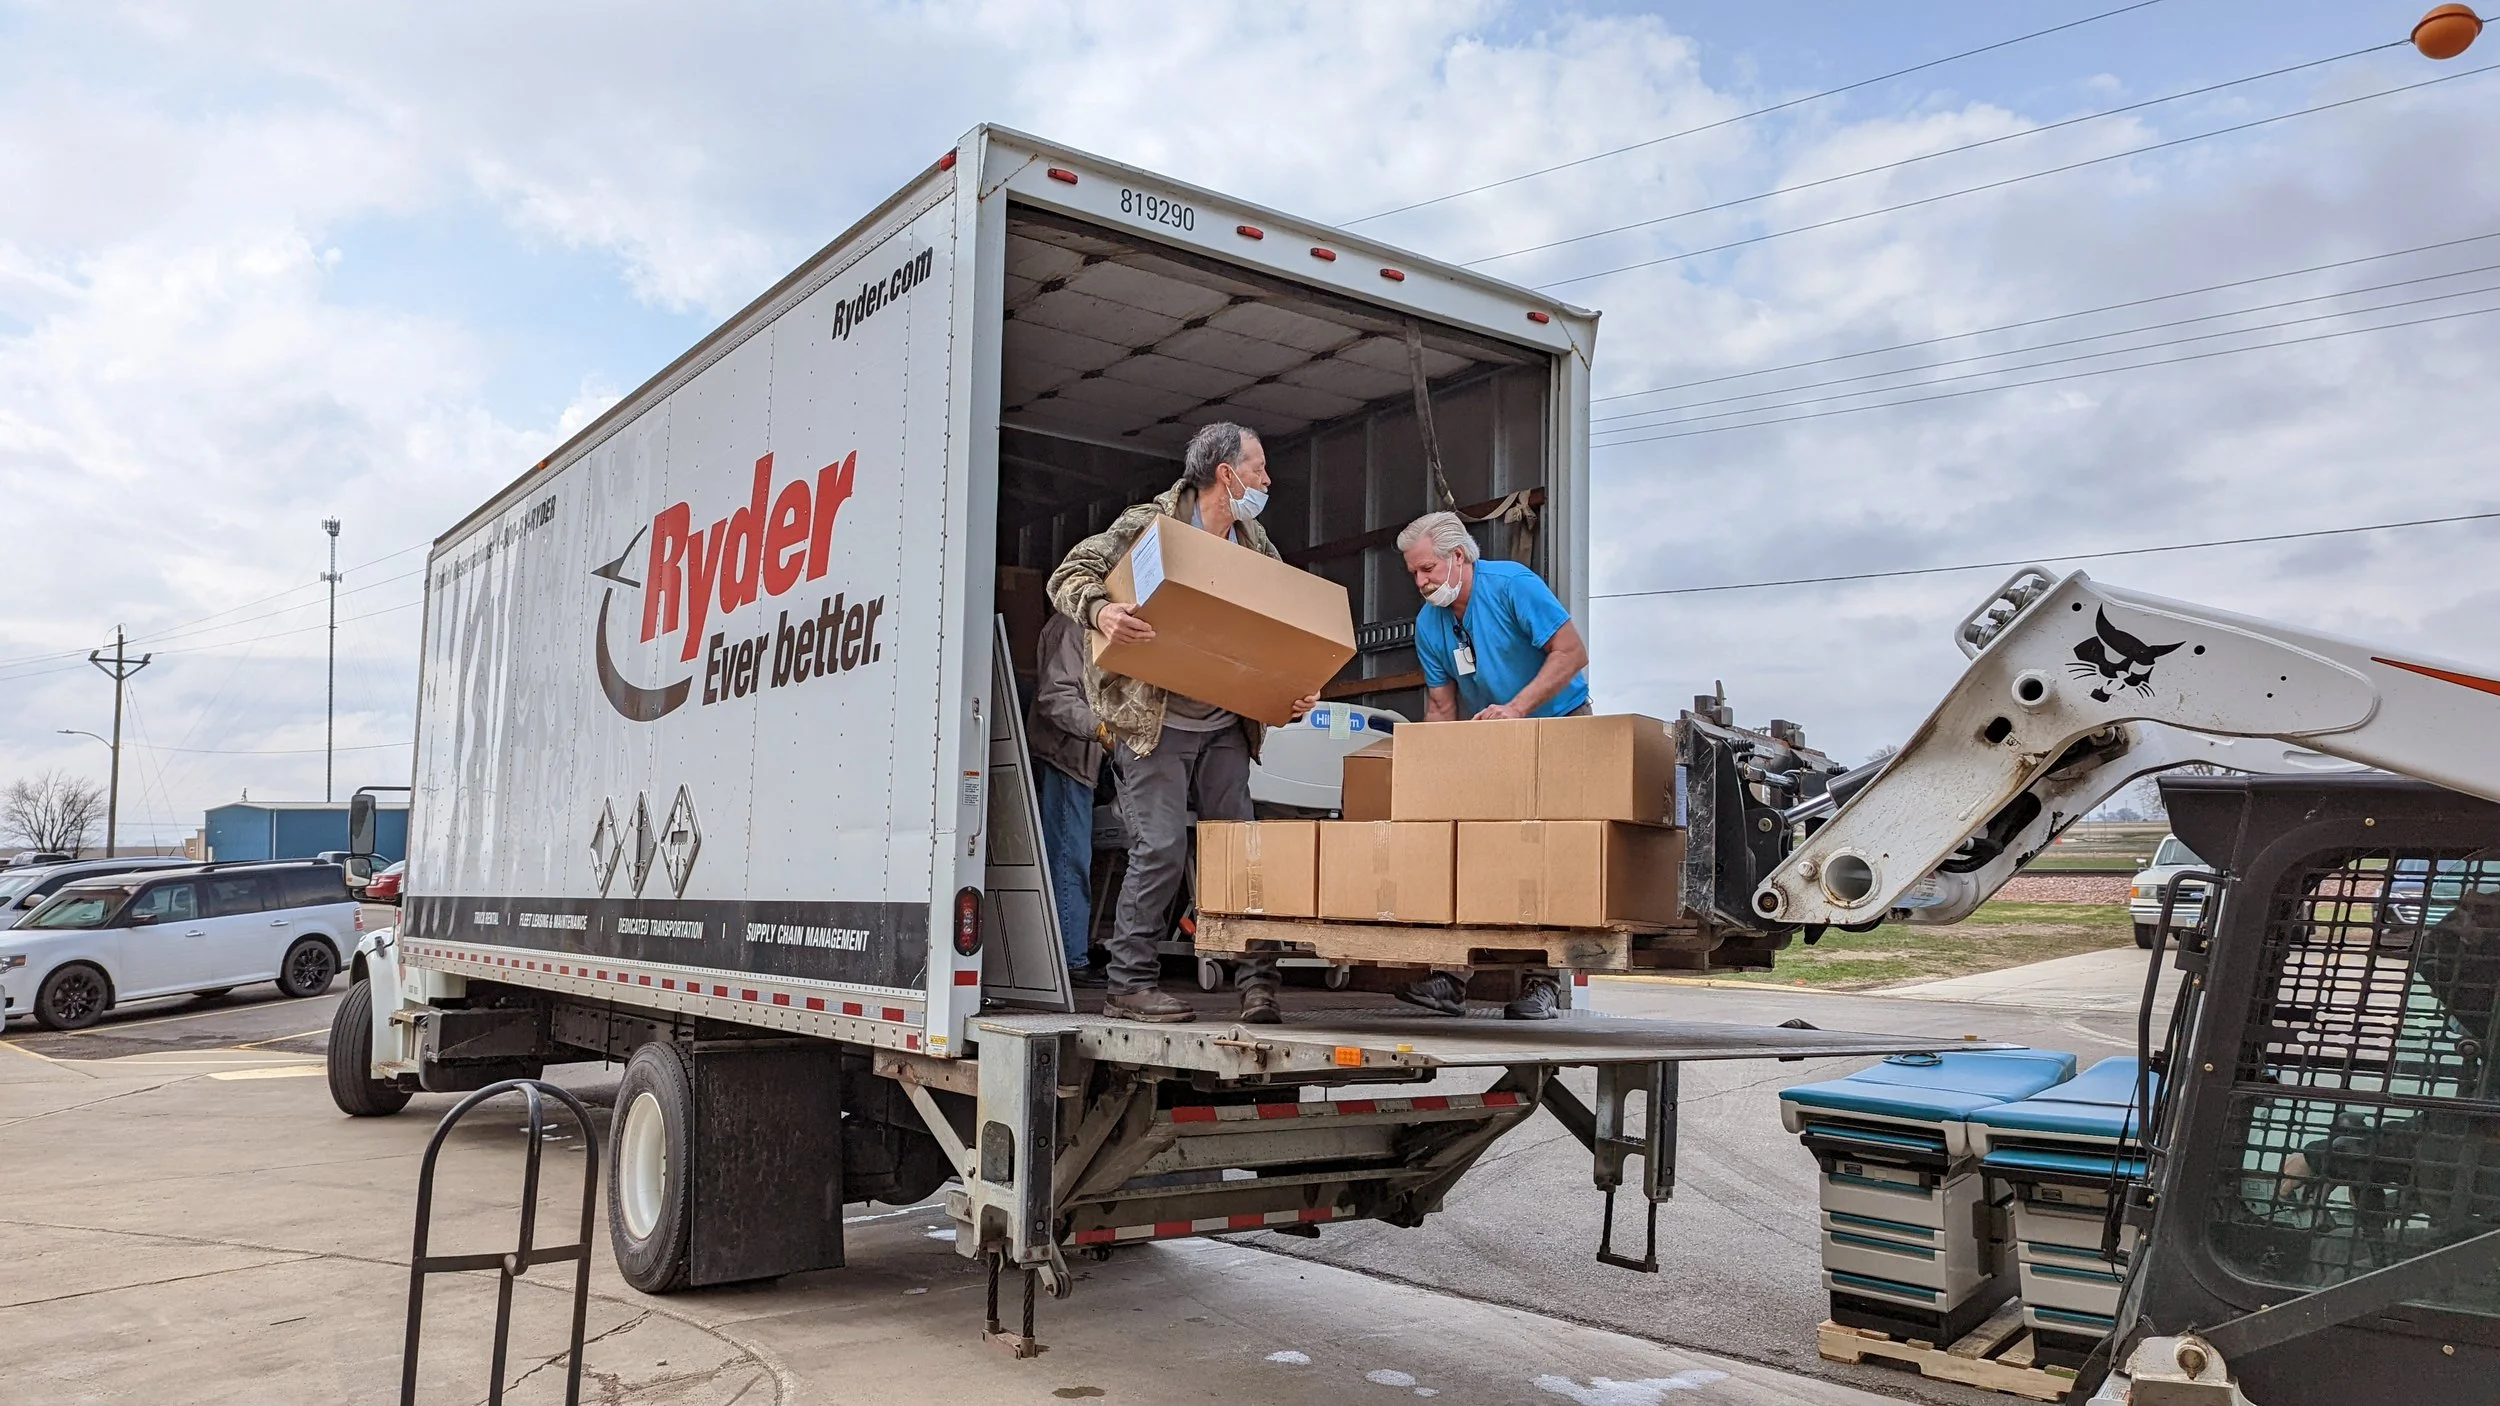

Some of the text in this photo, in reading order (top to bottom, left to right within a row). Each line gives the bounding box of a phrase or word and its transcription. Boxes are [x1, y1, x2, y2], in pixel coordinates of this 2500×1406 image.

[1120, 187, 1195, 232] 819290
[831, 245, 934, 340] Ryder.com
[640, 449, 857, 663] Ryder
[702, 592, 885, 706] Ever better.
[617, 917, 704, 939] DEDICATED TRANSPORTATION
[746, 922, 870, 951] SUPPLY CHAIN MANAGEMENT
